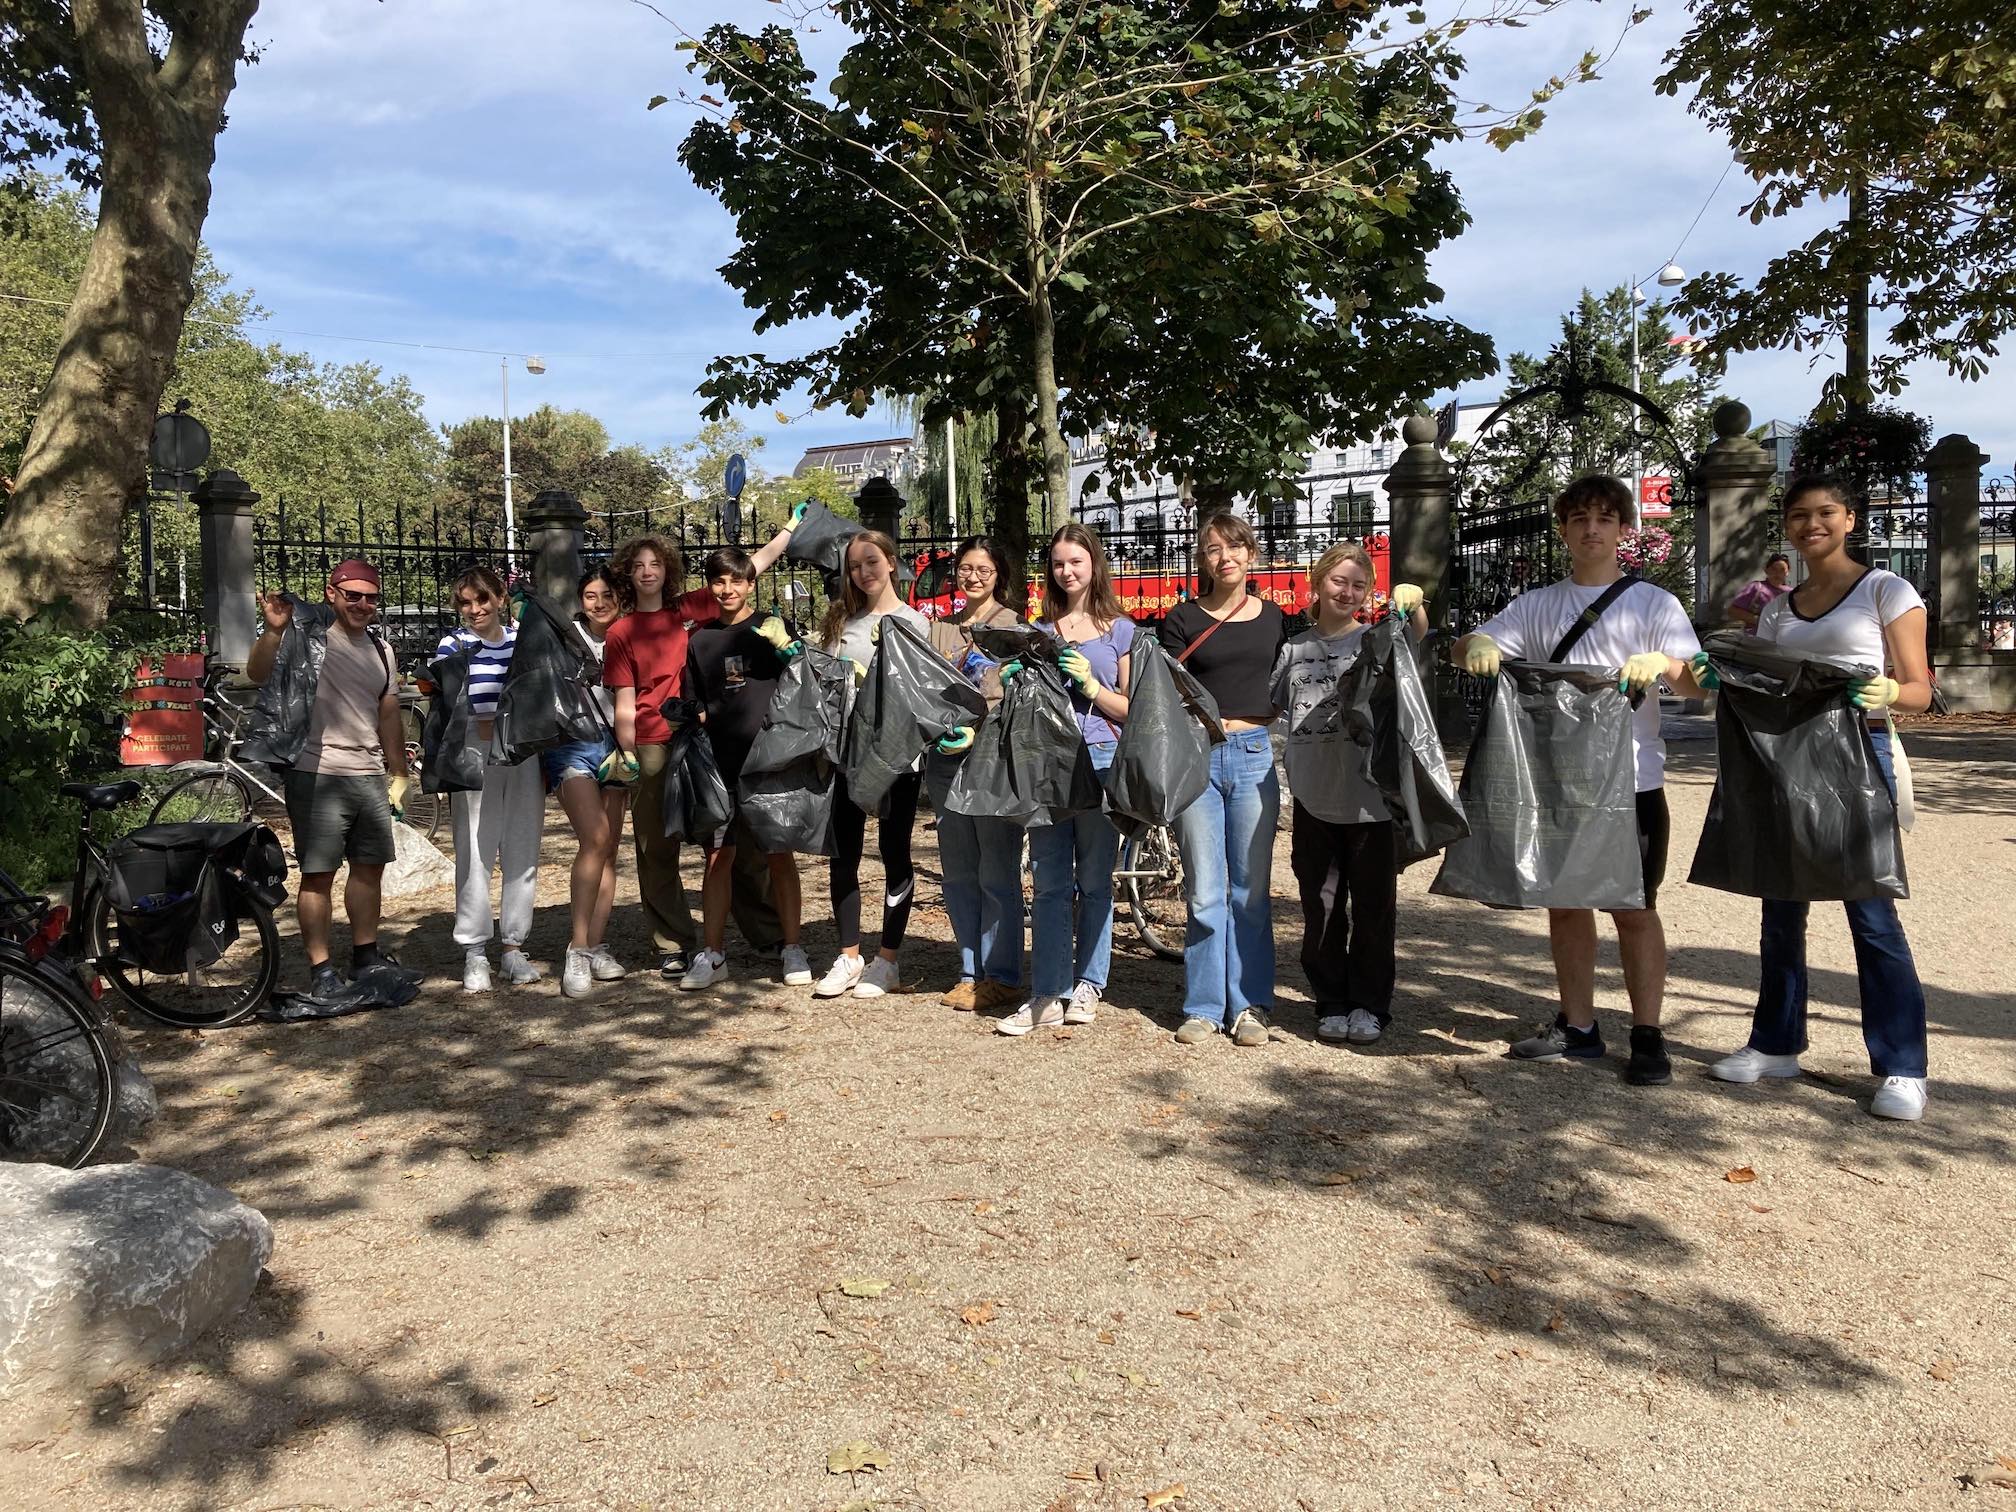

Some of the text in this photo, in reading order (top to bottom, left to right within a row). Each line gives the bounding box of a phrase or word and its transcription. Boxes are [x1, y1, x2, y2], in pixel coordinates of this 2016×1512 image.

[137, 679, 154, 688] ETI
[136, 734, 187, 742] CELEBRATE
[132, 743, 192, 752] PARTICIPATE
